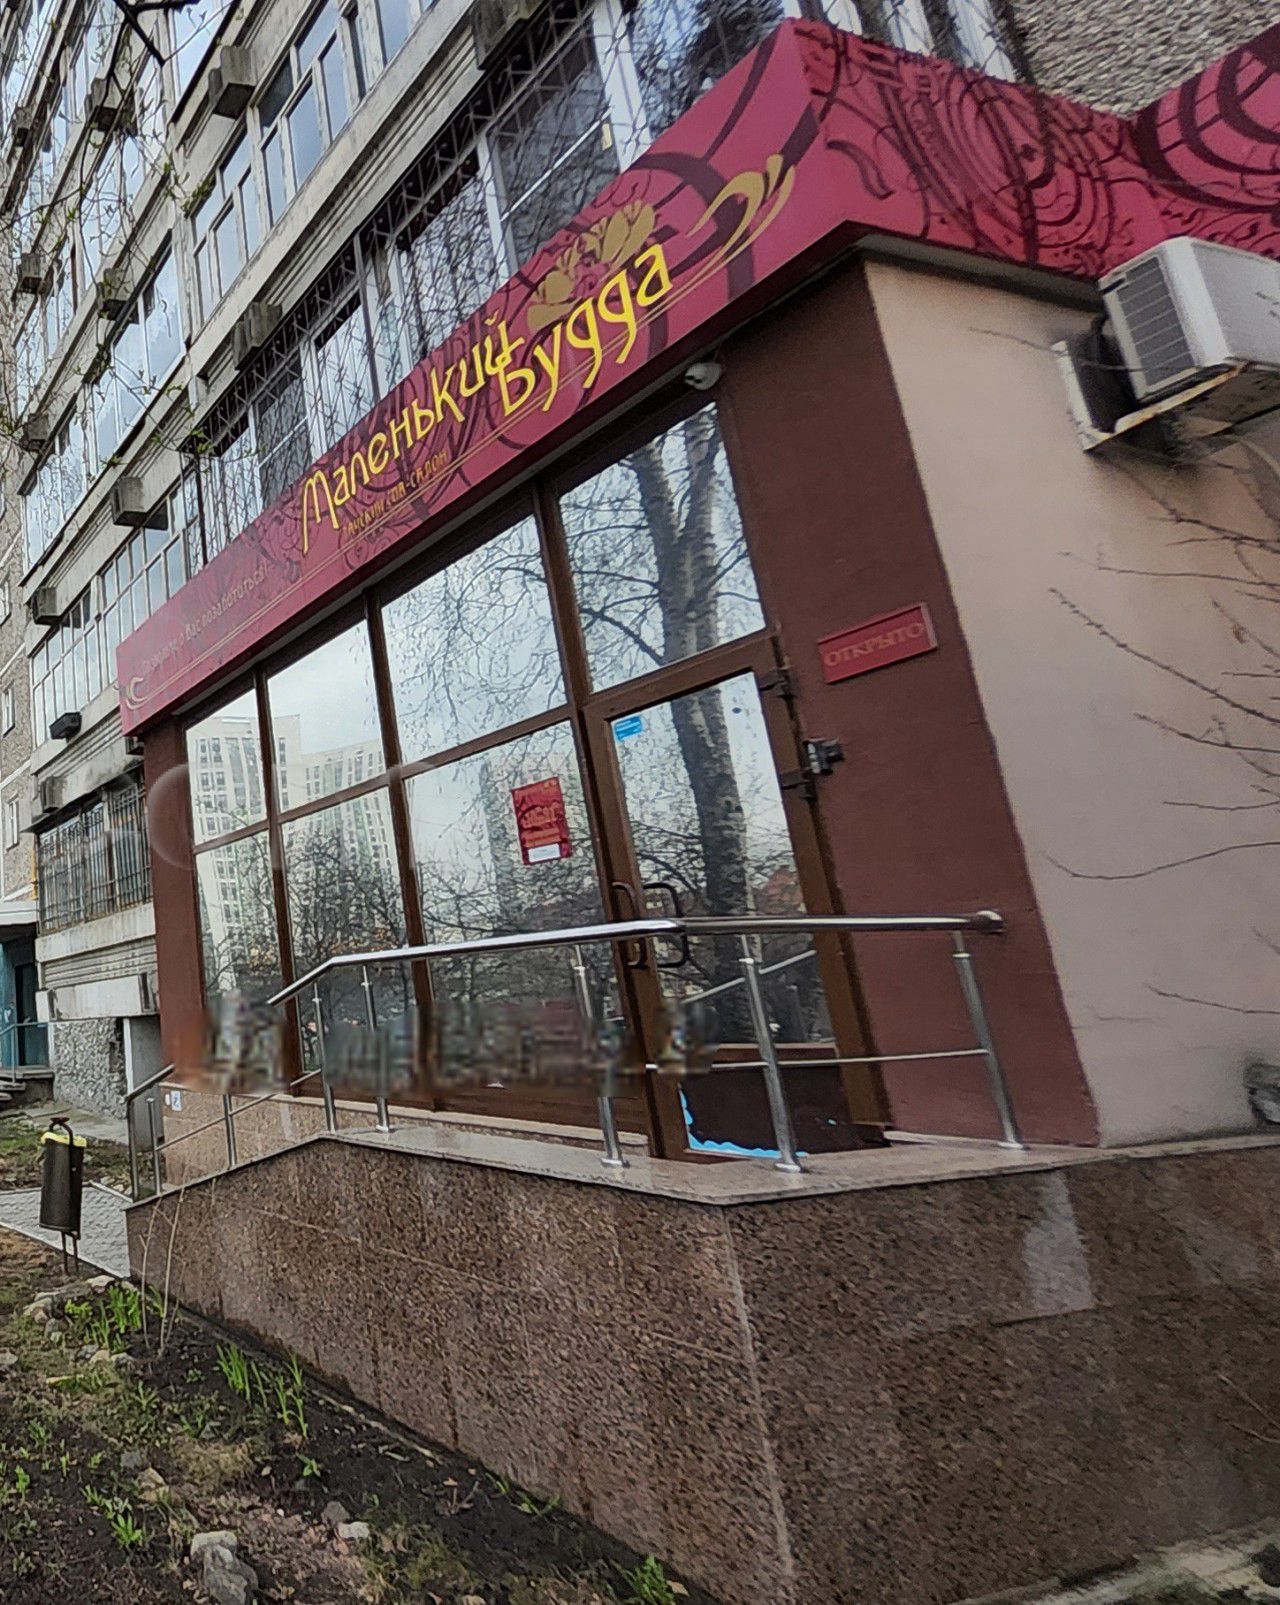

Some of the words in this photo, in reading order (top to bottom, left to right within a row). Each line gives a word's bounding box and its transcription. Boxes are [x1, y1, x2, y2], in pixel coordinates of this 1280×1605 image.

[301, 309, 513, 556] Маленький
[494, 242, 674, 417] Будда
[823, 621, 925, 667] ОТКРЫТО
